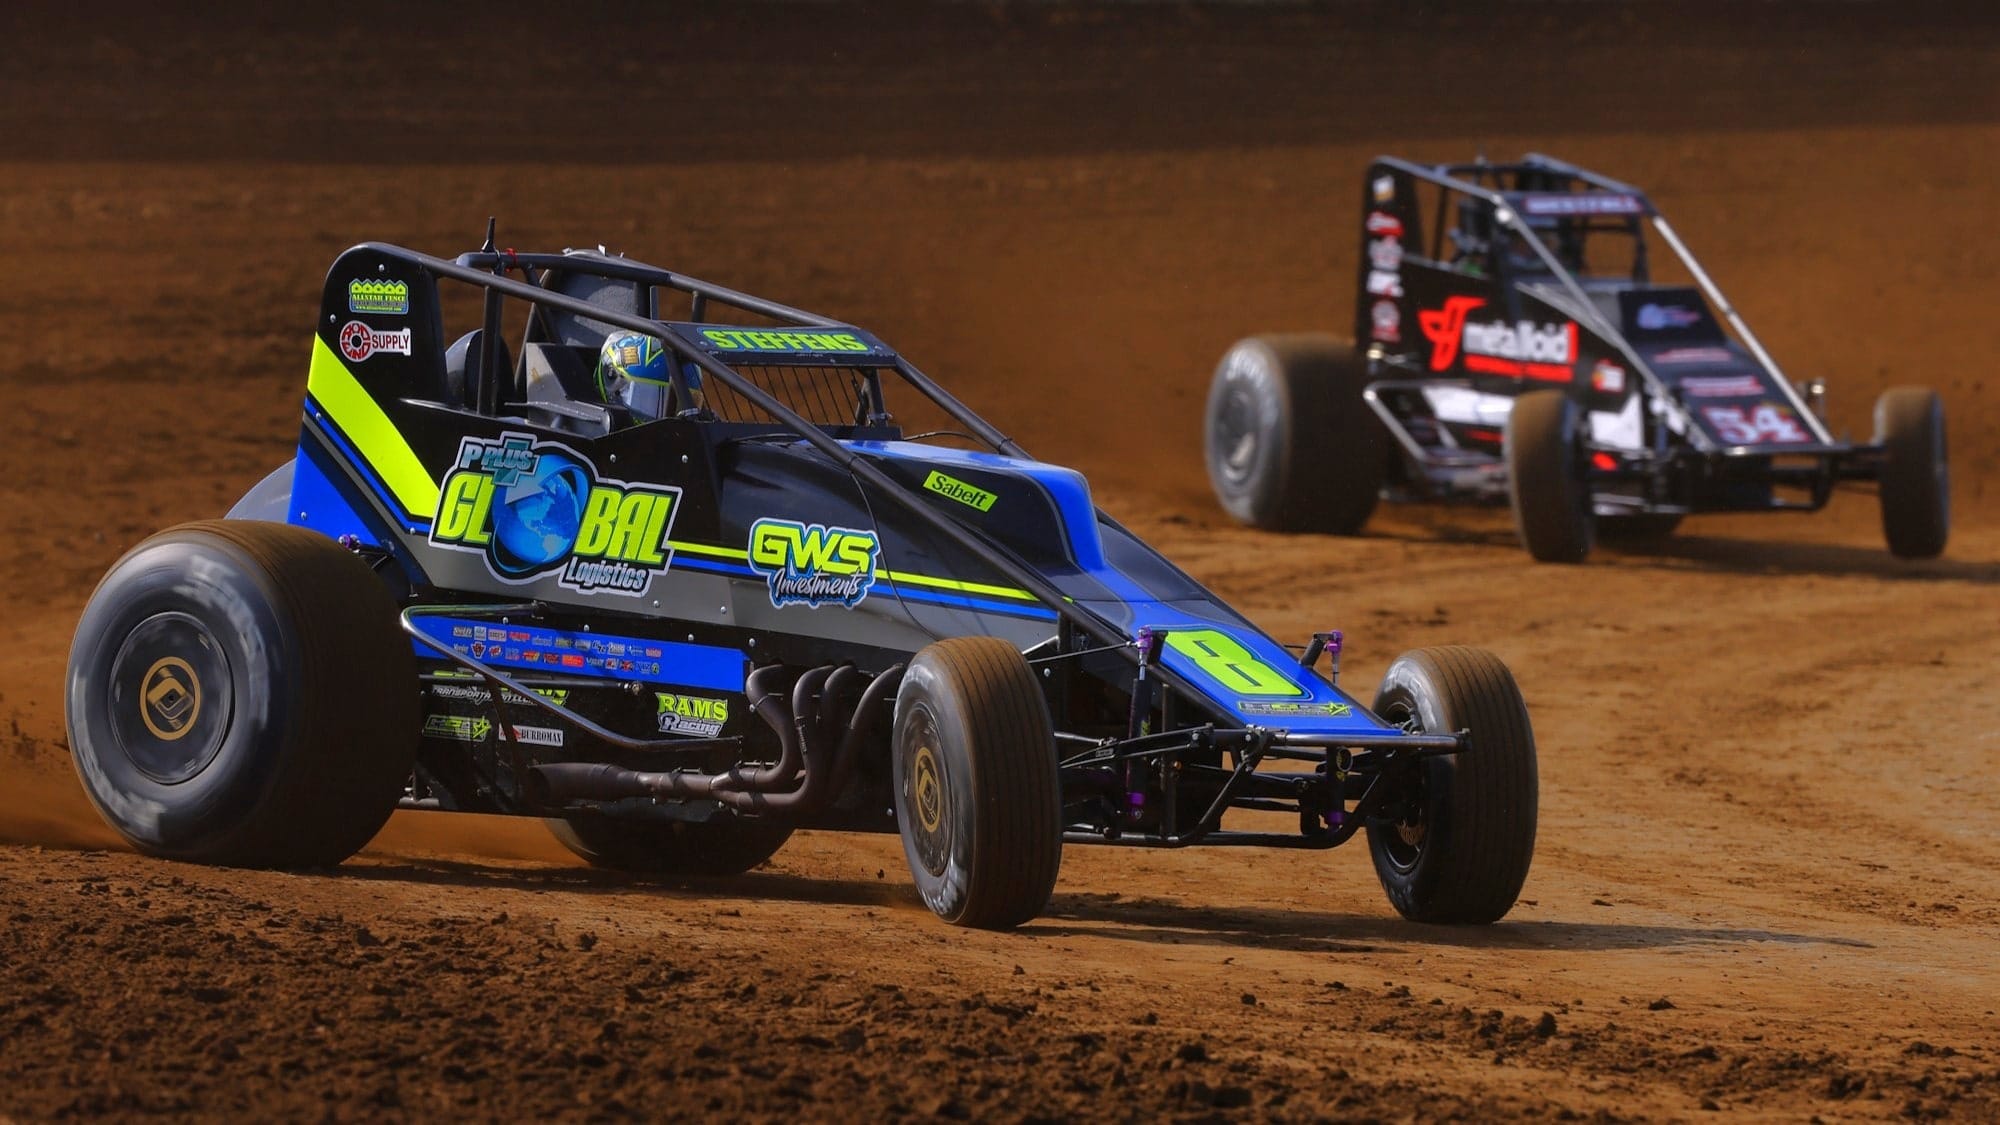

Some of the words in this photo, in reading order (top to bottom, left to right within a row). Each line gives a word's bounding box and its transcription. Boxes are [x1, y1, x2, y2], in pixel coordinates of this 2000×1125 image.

[372, 334, 409, 349] SUPPLY
[702, 330, 868, 351] STEFFENS
[931, 475, 988, 507] Sabelt
[752, 523, 874, 575] GWS
[565, 557, 646, 590] Logistics
[772, 565, 868, 599] Investments
[1165, 629, 1302, 695] 8
[657, 694, 727, 721] RAMS
[660, 712, 721, 736] Racing
